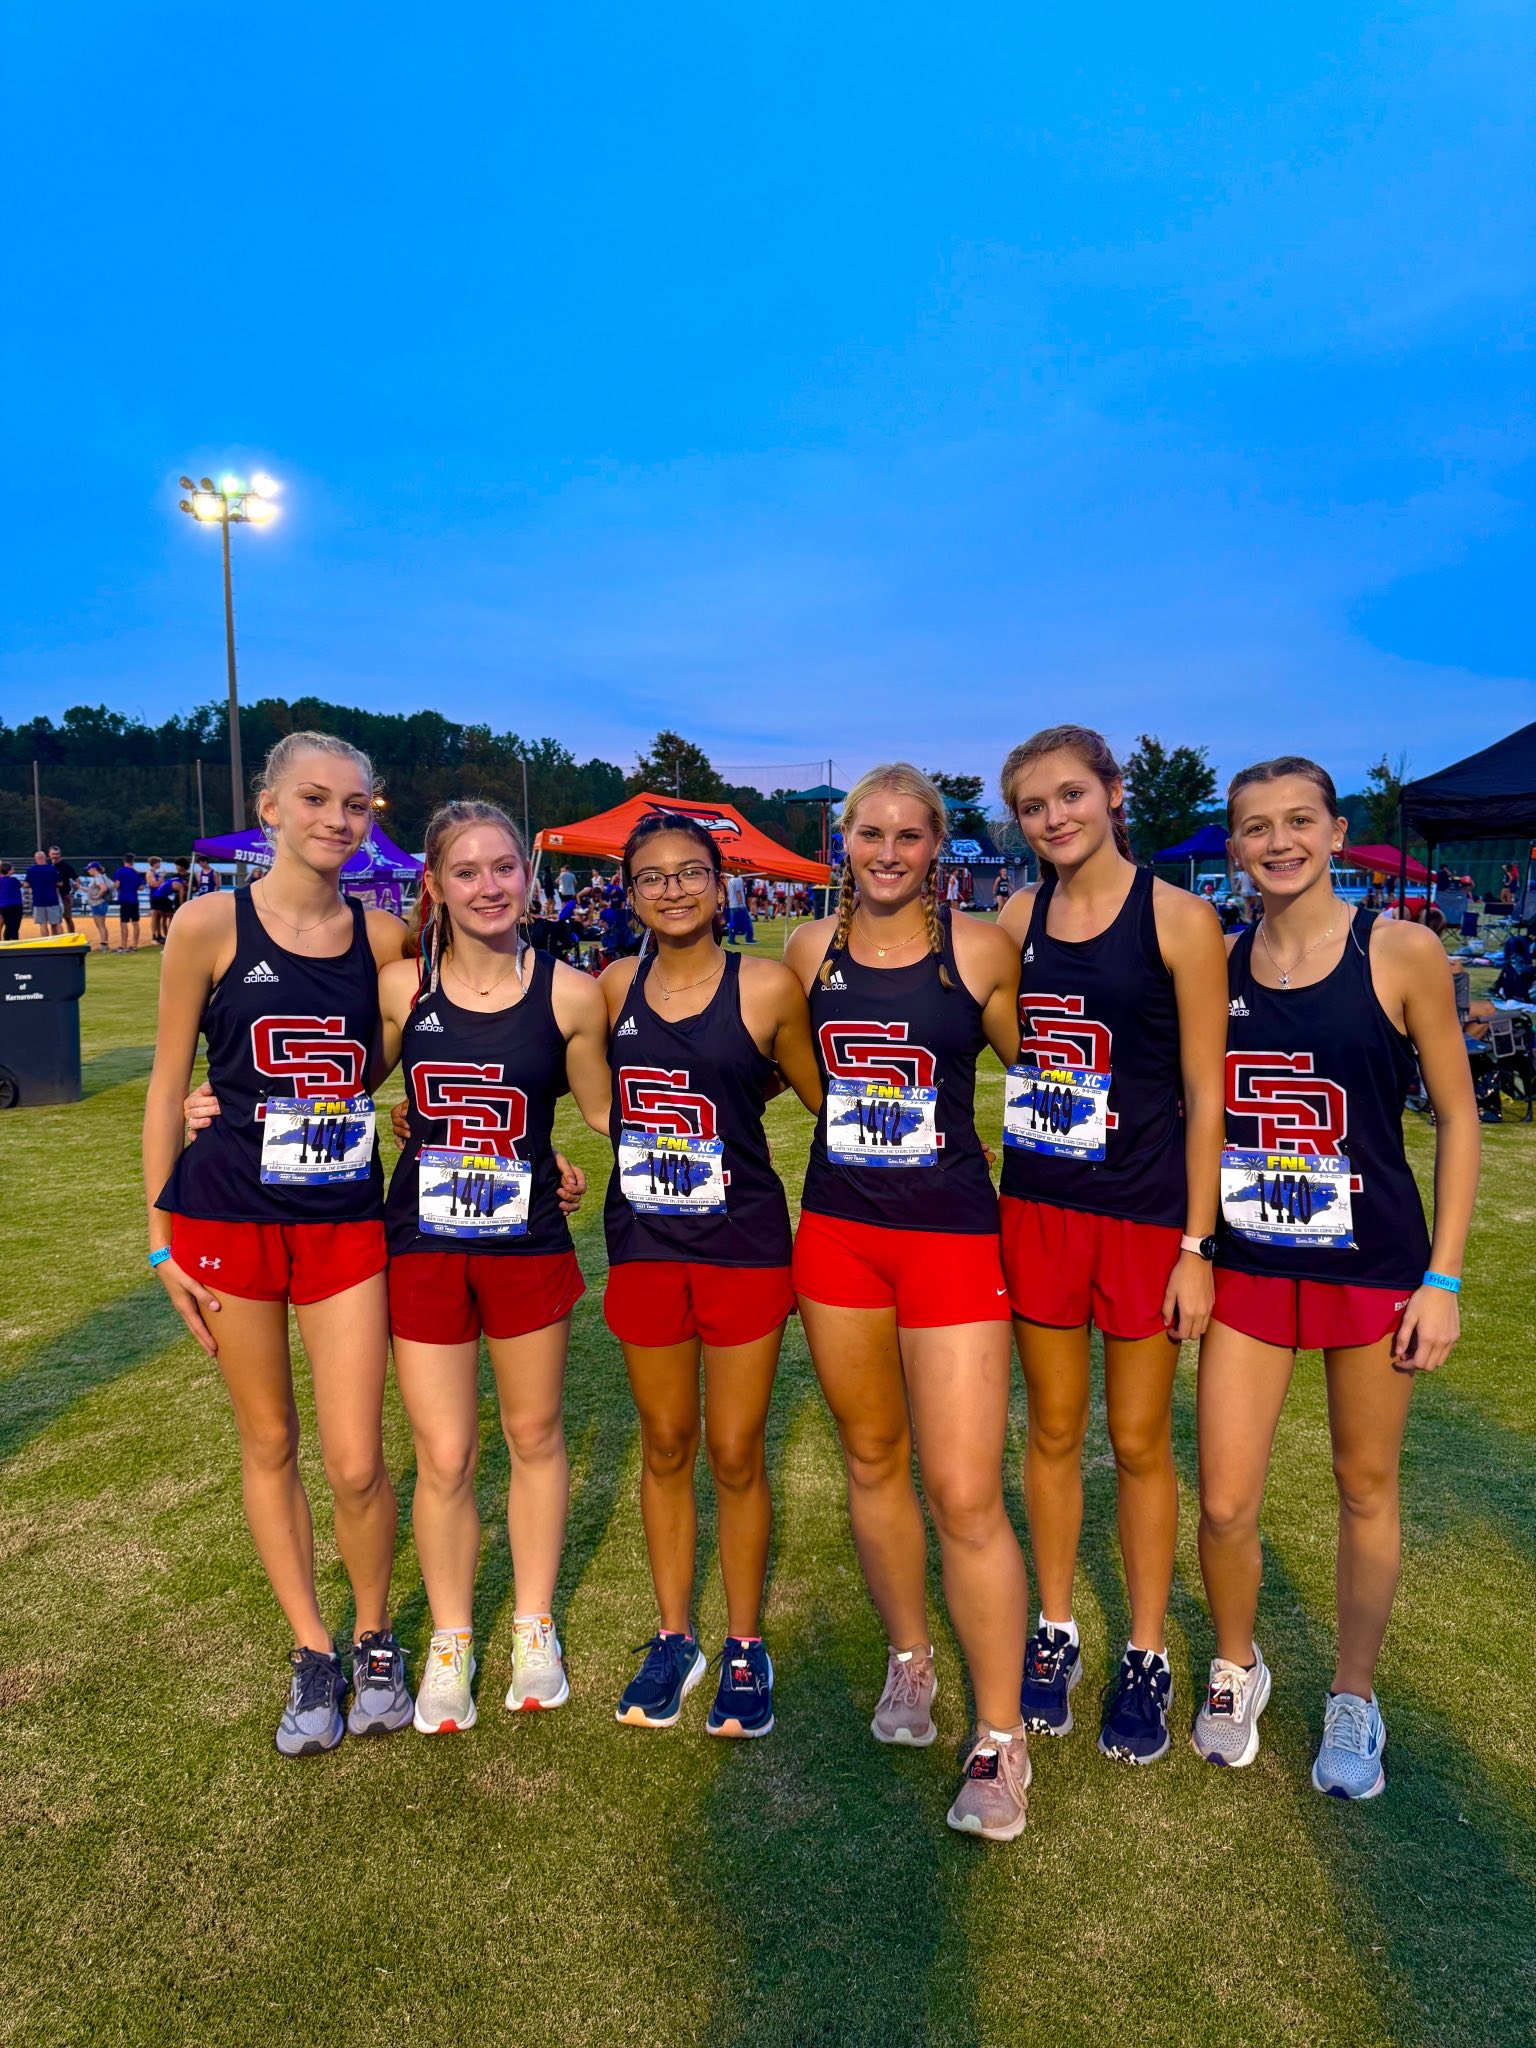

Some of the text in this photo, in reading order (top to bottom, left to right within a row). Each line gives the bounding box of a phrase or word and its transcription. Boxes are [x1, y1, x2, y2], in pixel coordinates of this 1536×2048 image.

[938, 856, 965, 864] UTLER
[243, 973, 279, 983] adidas
[5, 993, 44, 1001] Kernersville
[415, 1024, 444, 1033] adidas
[1040, 1069, 1077, 1085] FNL
[1082, 1074, 1103, 1088] XC
[866, 1084, 930, 1100] FNL XC
[314, 1099, 369, 1115] FNL XC
[1030, 1082, 1073, 1136] 1469
[856, 1100, 902, 1146] 1472
[299, 1116, 347, 1164] 1474
[656, 1135, 692, 1151] FNL
[697, 1141, 716, 1153] XC
[462, 1155, 524, 1172] FNL XC
[1266, 1155, 1340, 1172] FNL XC
[647, 1151, 692, 1197] 1473
[450, 1171, 495, 1217] 1471
[1257, 1173, 1311, 1225] 1470
[1429, 1274, 1455, 1289] Friday
